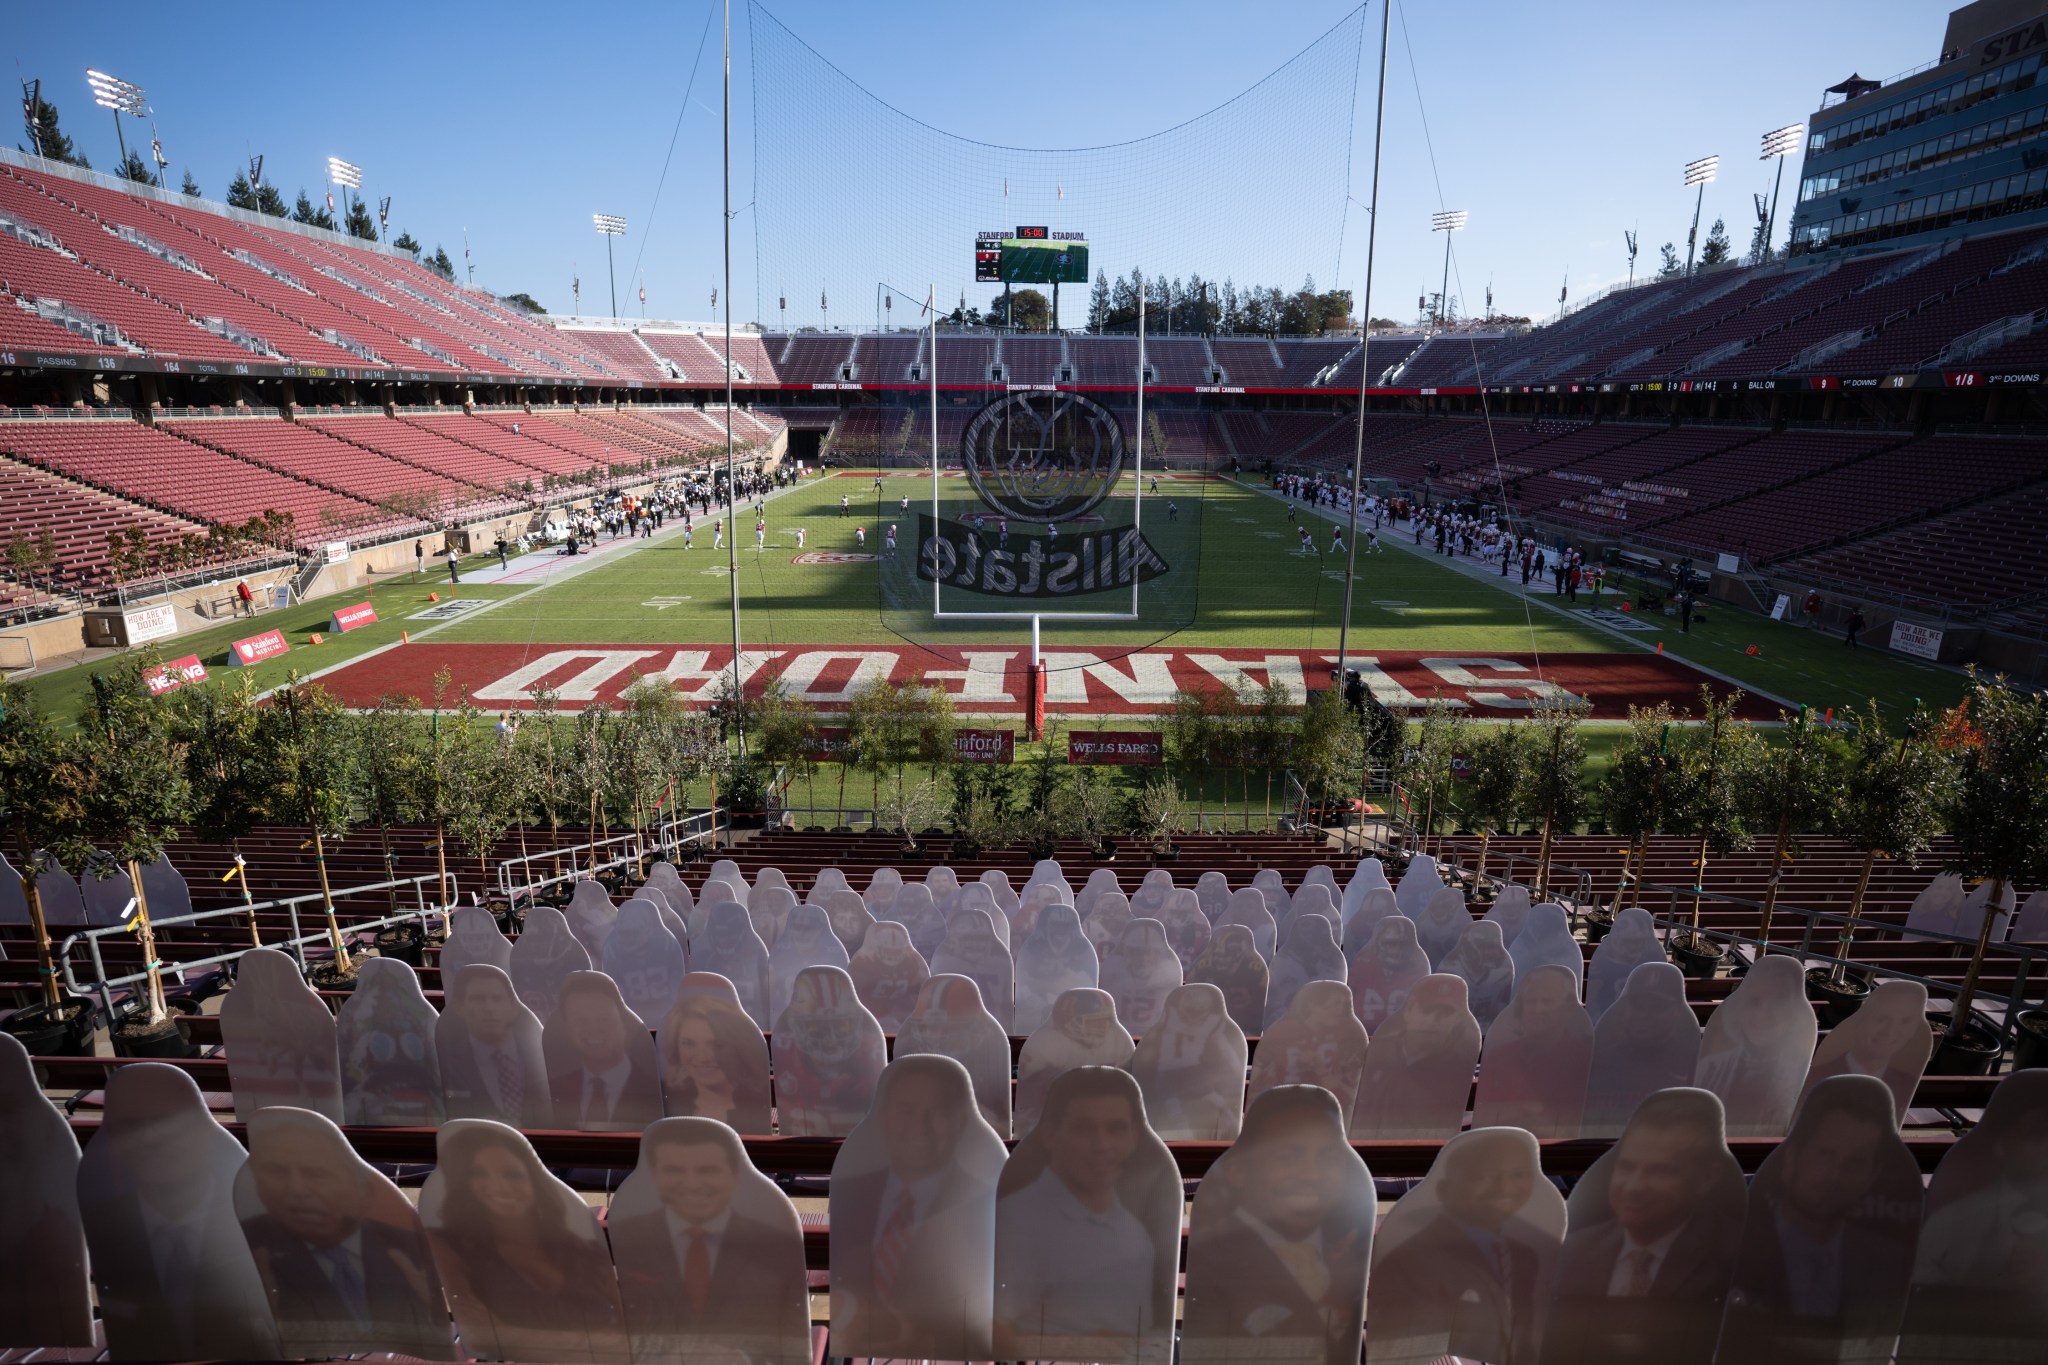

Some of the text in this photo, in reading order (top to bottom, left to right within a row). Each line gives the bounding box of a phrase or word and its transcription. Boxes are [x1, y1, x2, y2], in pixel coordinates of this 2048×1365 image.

[1023, 229, 1043, 237] 15:00
[1052, 232, 1084, 240] STADIUM
[37, 357, 76, 366] PASSING
[98, 358, 116, 369] 136
[164, 362, 249, 374] 164 TOTAL 194
[308, 368, 326, 377] 15:00
[1748, 381, 1775, 389] BALL ON
[1821, 379, 1827, 389] 9
[1893, 377, 1904, 387] 10
[1955, 373, 1974, 386] 1/8
[2003, 374, 2040, 383] DOWNS
[1647, 383, 1662, 391] 15:00
[329, 548, 347, 559] ESPN
[127, 606, 172, 624] HOW ARE WE
[339, 608, 373, 625] WELLS FARGO
[1895, 622, 1941, 641] HOW ARE WE
[252, 634, 279, 651] Stanford
[256, 642, 283, 656] MEDICINE
[1074, 743, 1158, 754] WELLS FARGO
